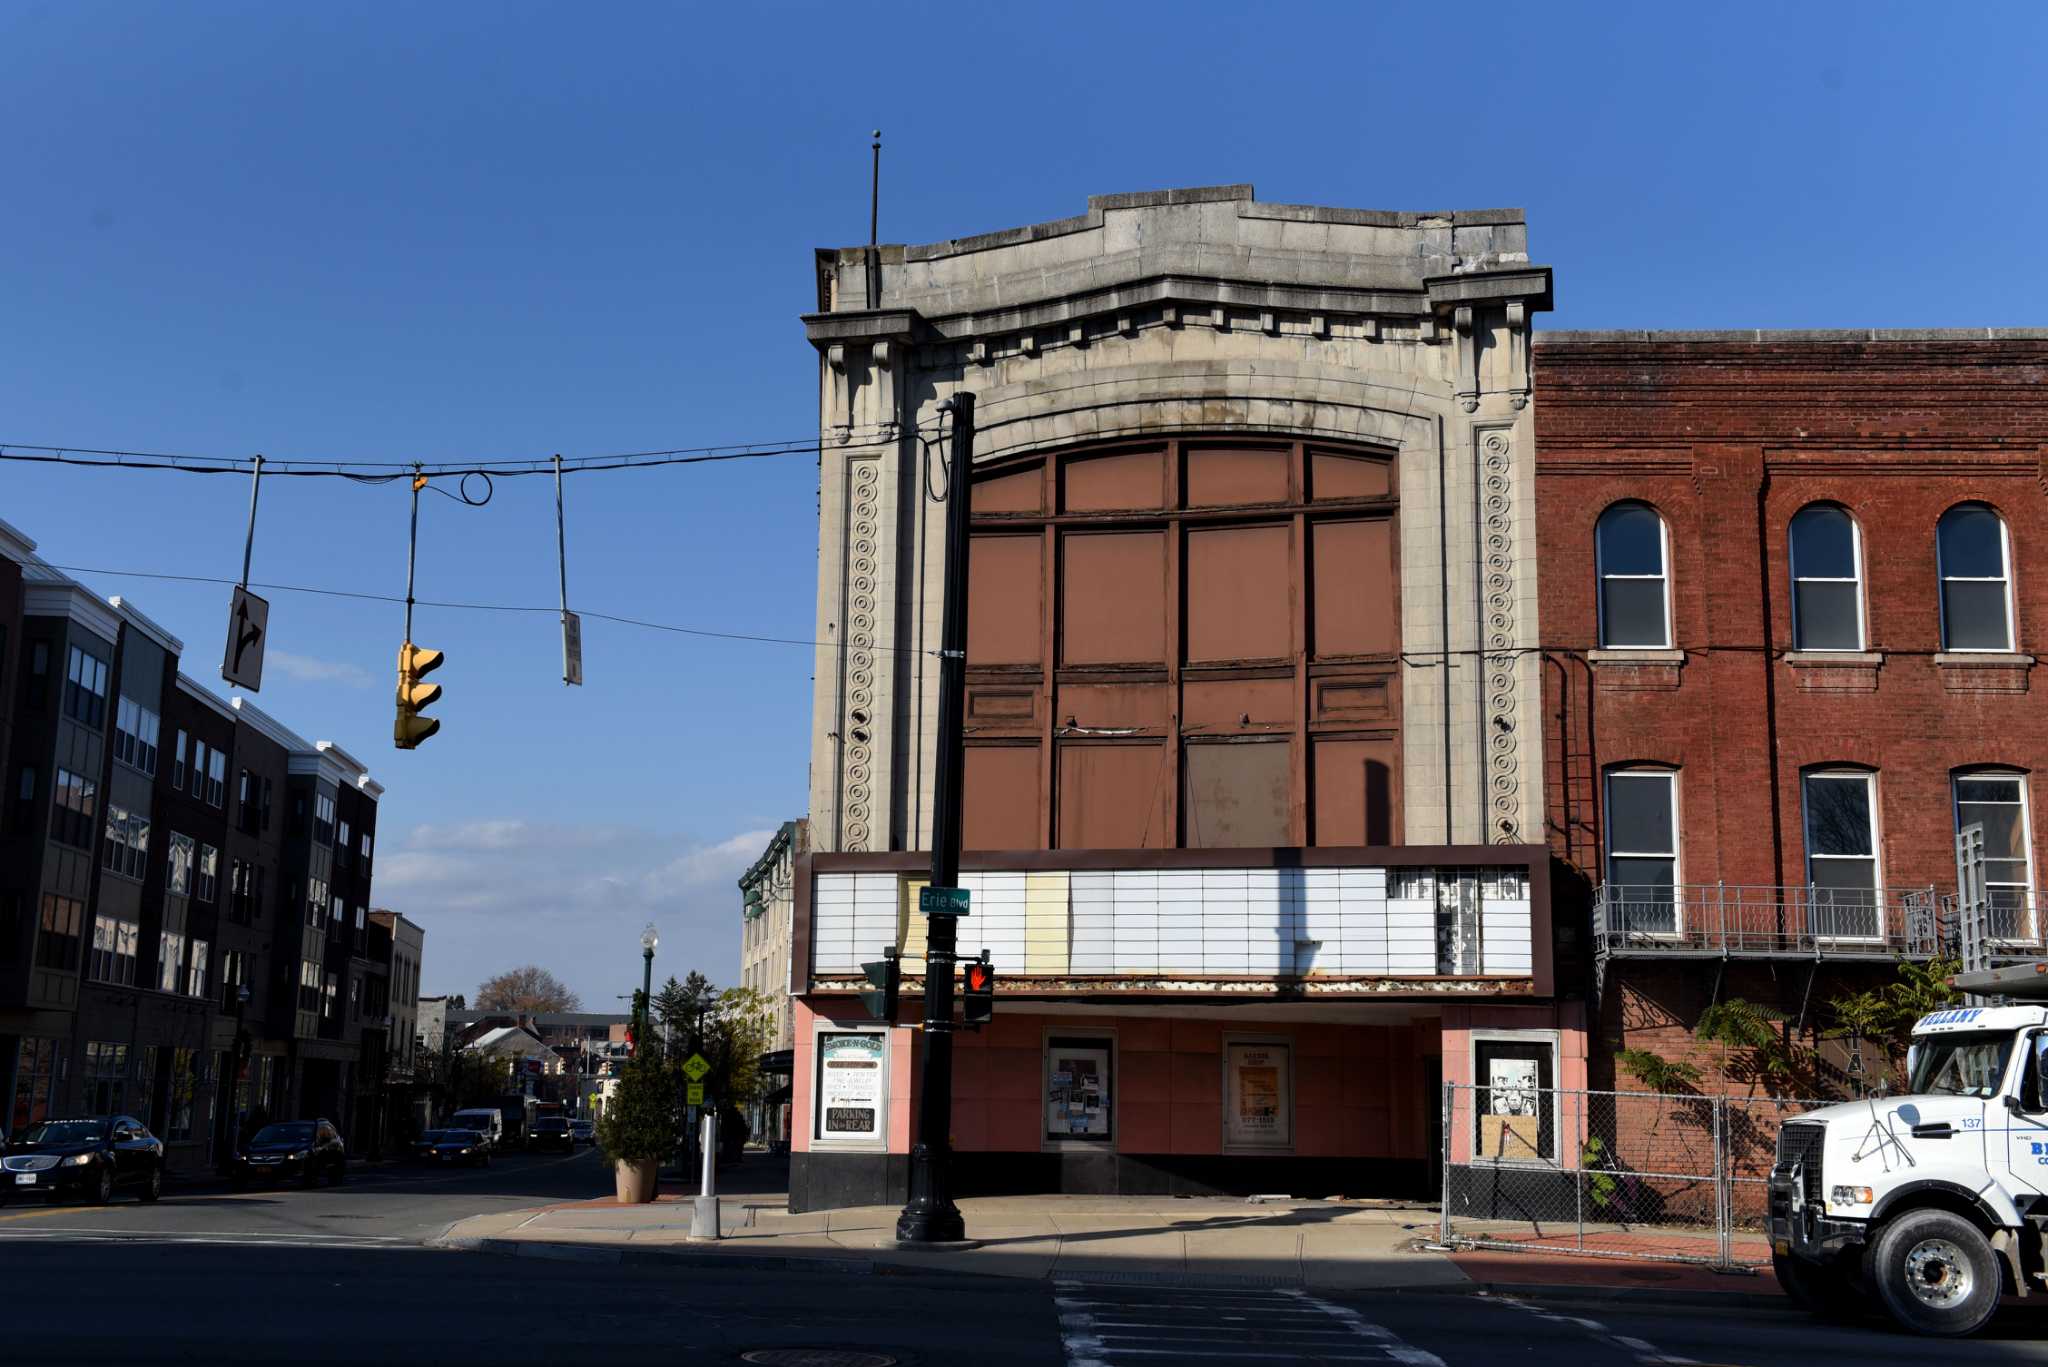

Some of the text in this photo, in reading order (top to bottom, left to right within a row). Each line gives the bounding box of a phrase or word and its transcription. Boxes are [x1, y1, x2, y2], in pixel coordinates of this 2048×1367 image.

[922, 893, 969, 908] Erie Blvd
[832, 1109, 870, 1119] PARKING
[828, 1120, 839, 1130] IN
[846, 1120, 871, 1130] REAR
[1961, 1118, 1981, 1128] 137
